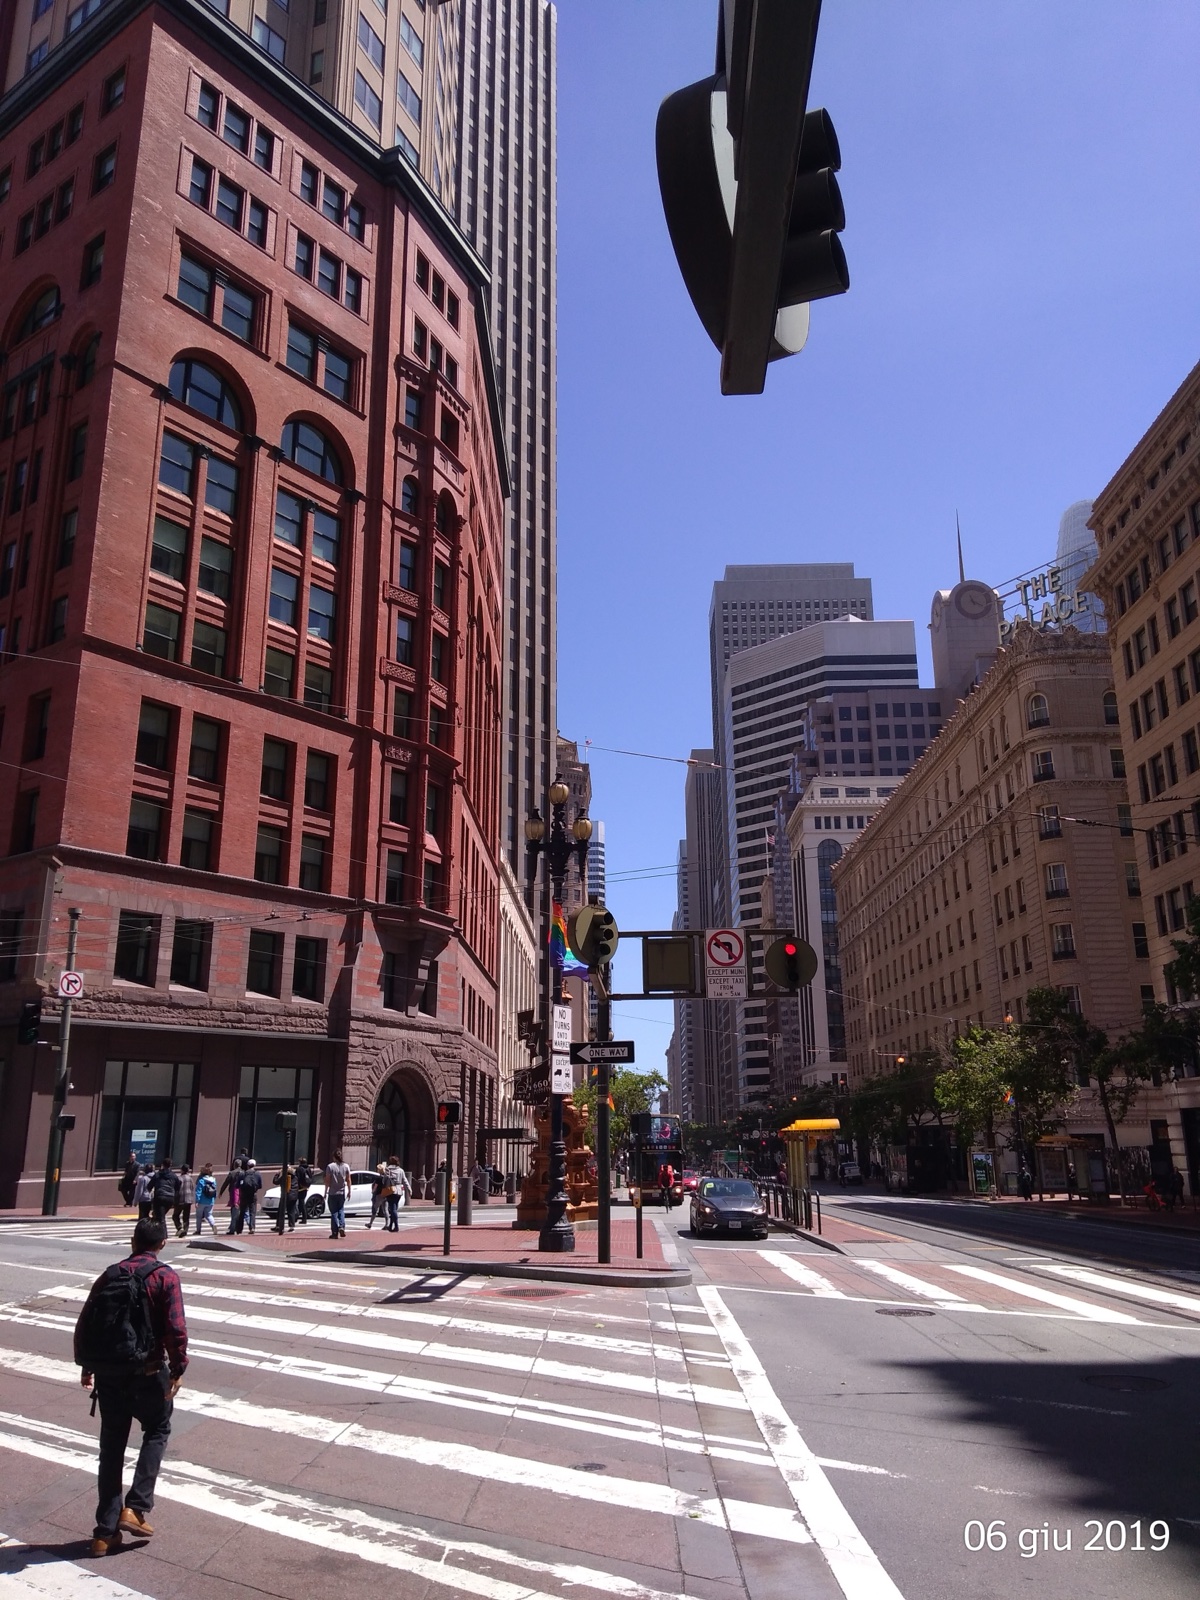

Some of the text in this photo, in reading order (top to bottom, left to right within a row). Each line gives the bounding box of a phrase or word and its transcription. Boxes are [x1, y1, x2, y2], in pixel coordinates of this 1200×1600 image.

[1016, 566, 1062, 606] THE
[559, 1009, 566, 1019] NO
[554, 1021, 570, 1031] TURNS
[608, 1048, 626, 1056] WAY
[533, 1079, 549, 1089] 660
